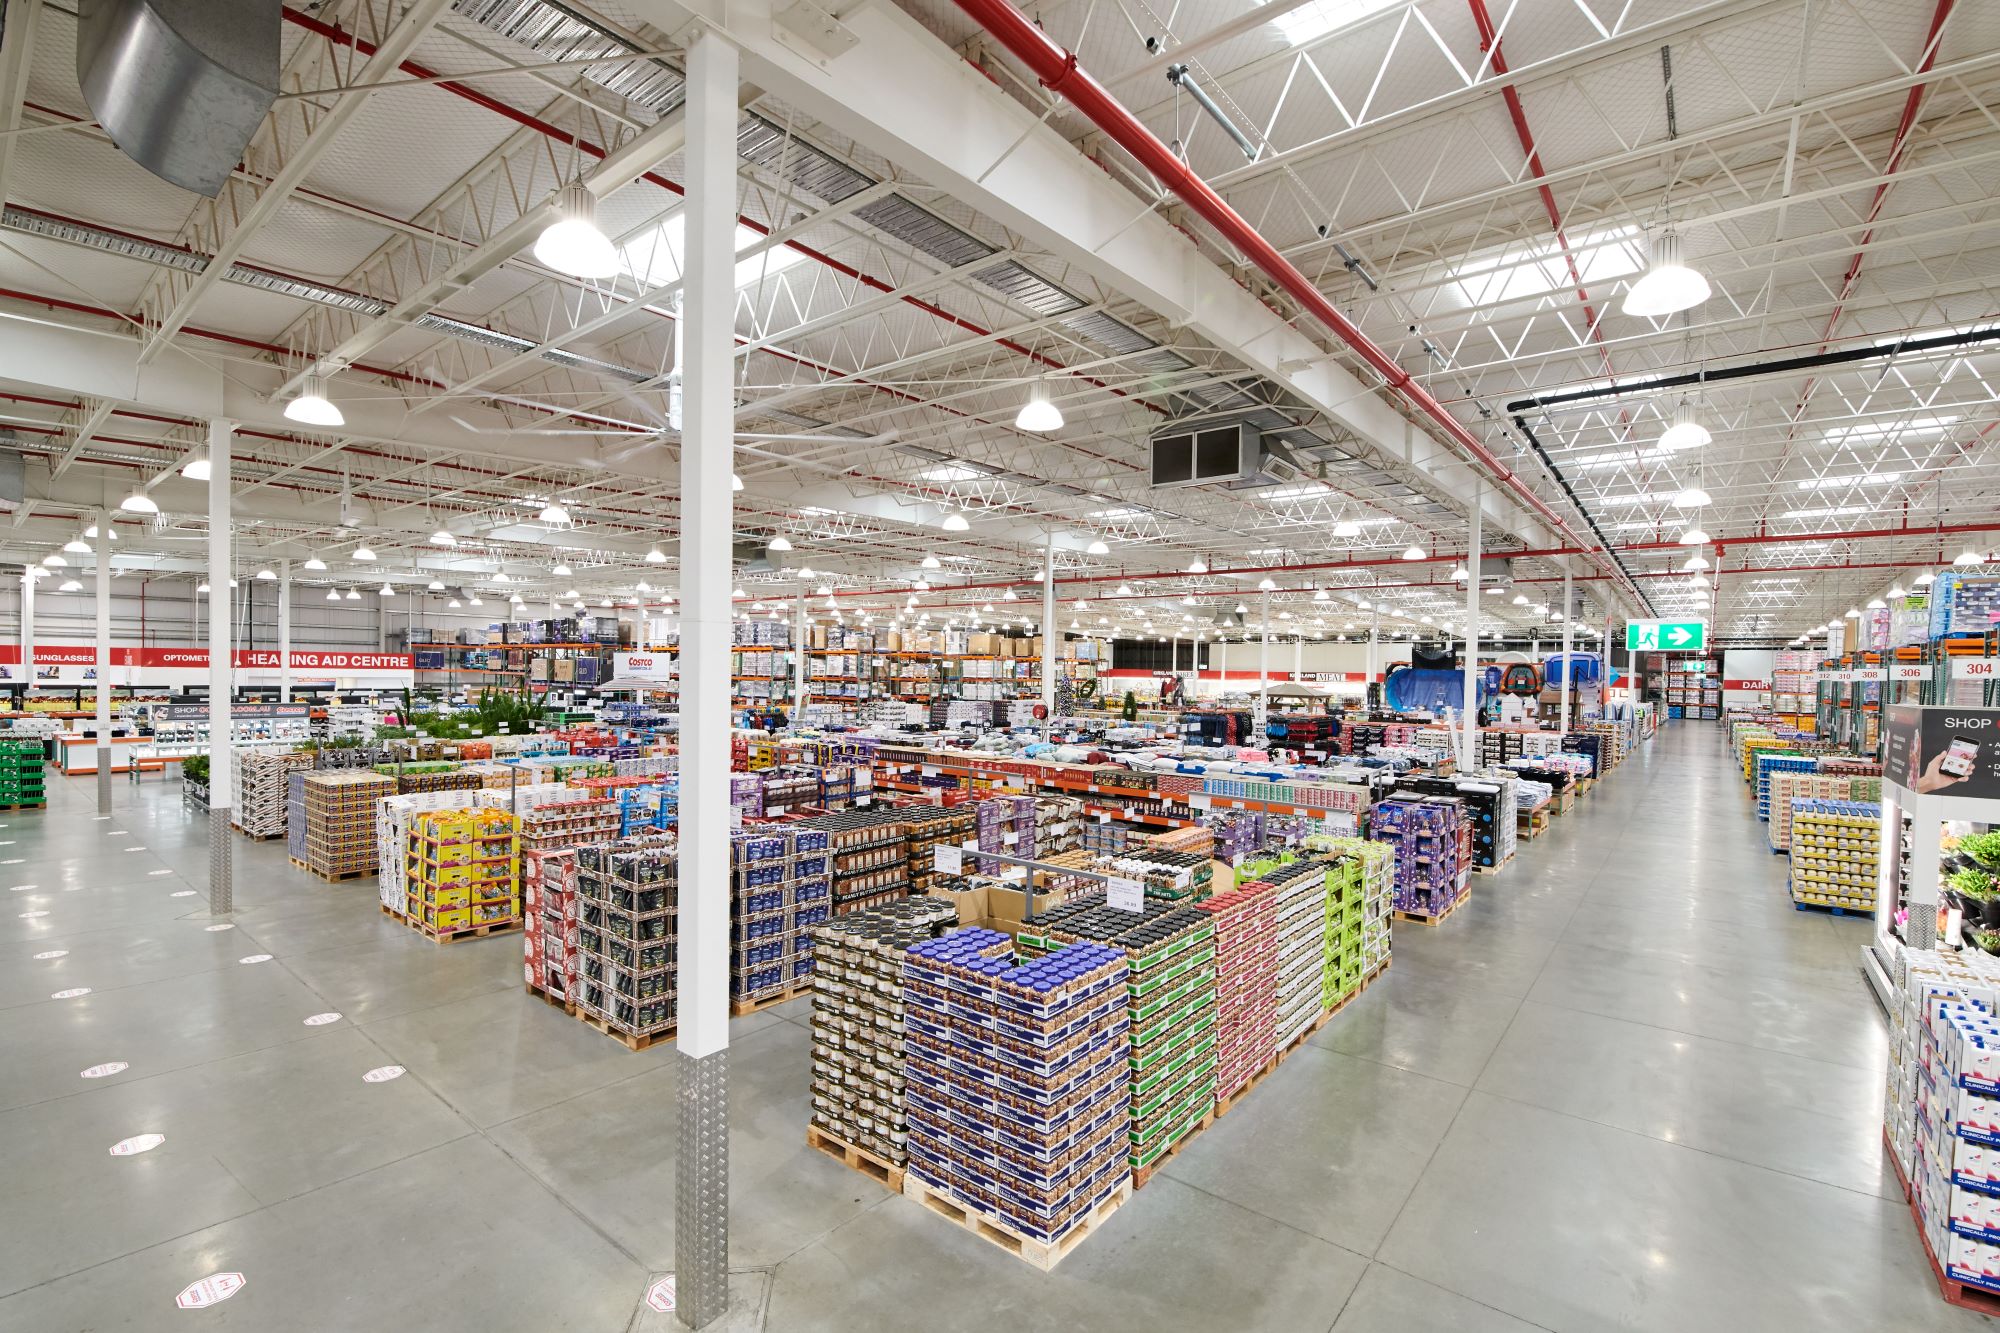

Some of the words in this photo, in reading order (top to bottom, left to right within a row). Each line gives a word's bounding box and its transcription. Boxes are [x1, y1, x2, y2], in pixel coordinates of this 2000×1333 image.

[163, 654, 210, 662] OPTOMET
[248, 653, 318, 666] HEAING
[322, 655, 348, 666] AID
[350, 655, 408, 668] CENTRE
[1900, 668, 1920, 677] 306
[1966, 663, 1992, 674] 304
[1944, 717, 1992, 728] SHOP
[1964, 1082, 1999, 1092] CLINICALLY
[1960, 1130, 1994, 1142] CLINICALLY
[1958, 1178, 1990, 1190] CLINICALLY
[1954, 1225, 1988, 1237] CLINICALLY
[1952, 1272, 1984, 1284] CLINICALLY
